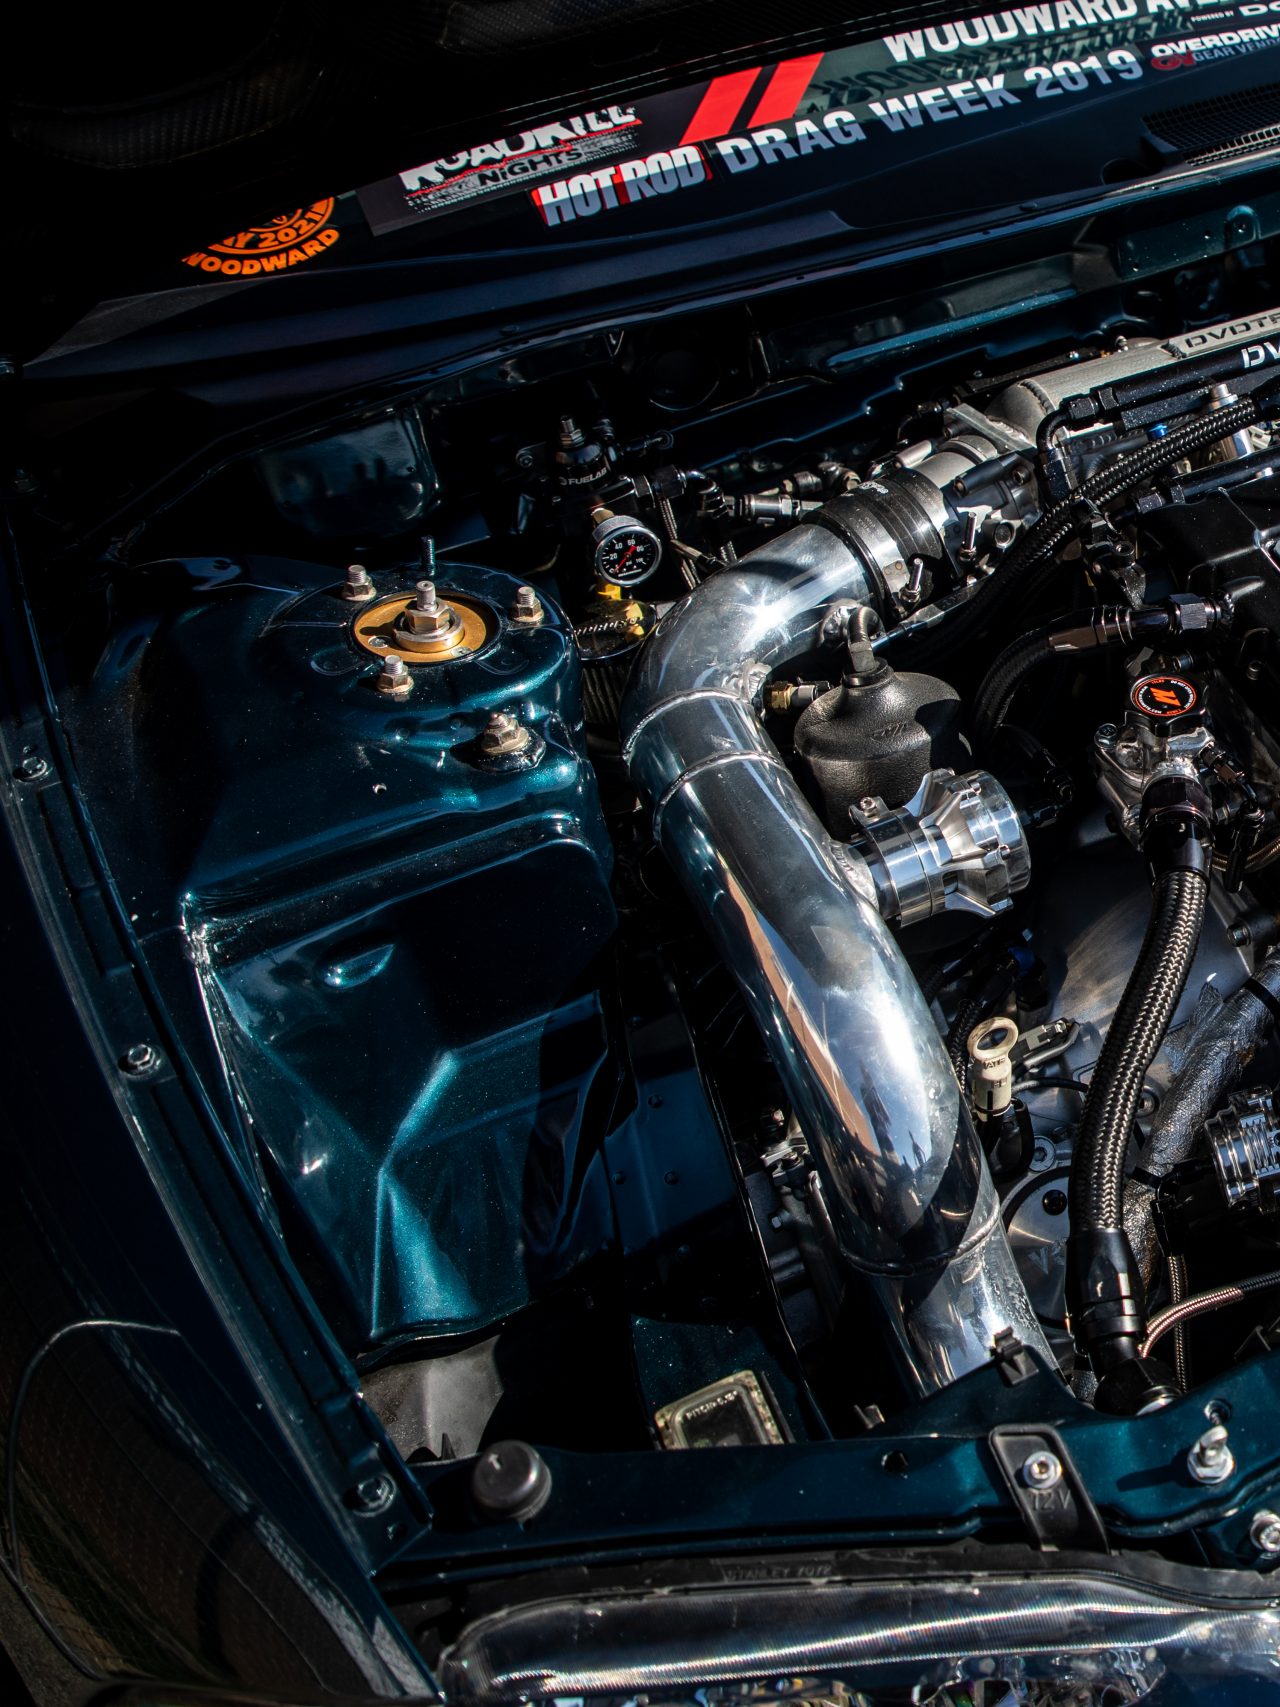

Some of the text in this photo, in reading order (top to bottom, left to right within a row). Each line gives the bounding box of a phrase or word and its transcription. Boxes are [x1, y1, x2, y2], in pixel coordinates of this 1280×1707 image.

[882, 0, 1139, 63] WOODWARD
[1195, 46, 1235, 62] GEAR
[537, 49, 1144, 227] HOT ROD DRAG WEEK 2019
[258, 209, 323, 249] 2021
[568, 467, 608, 486] FUELAB
